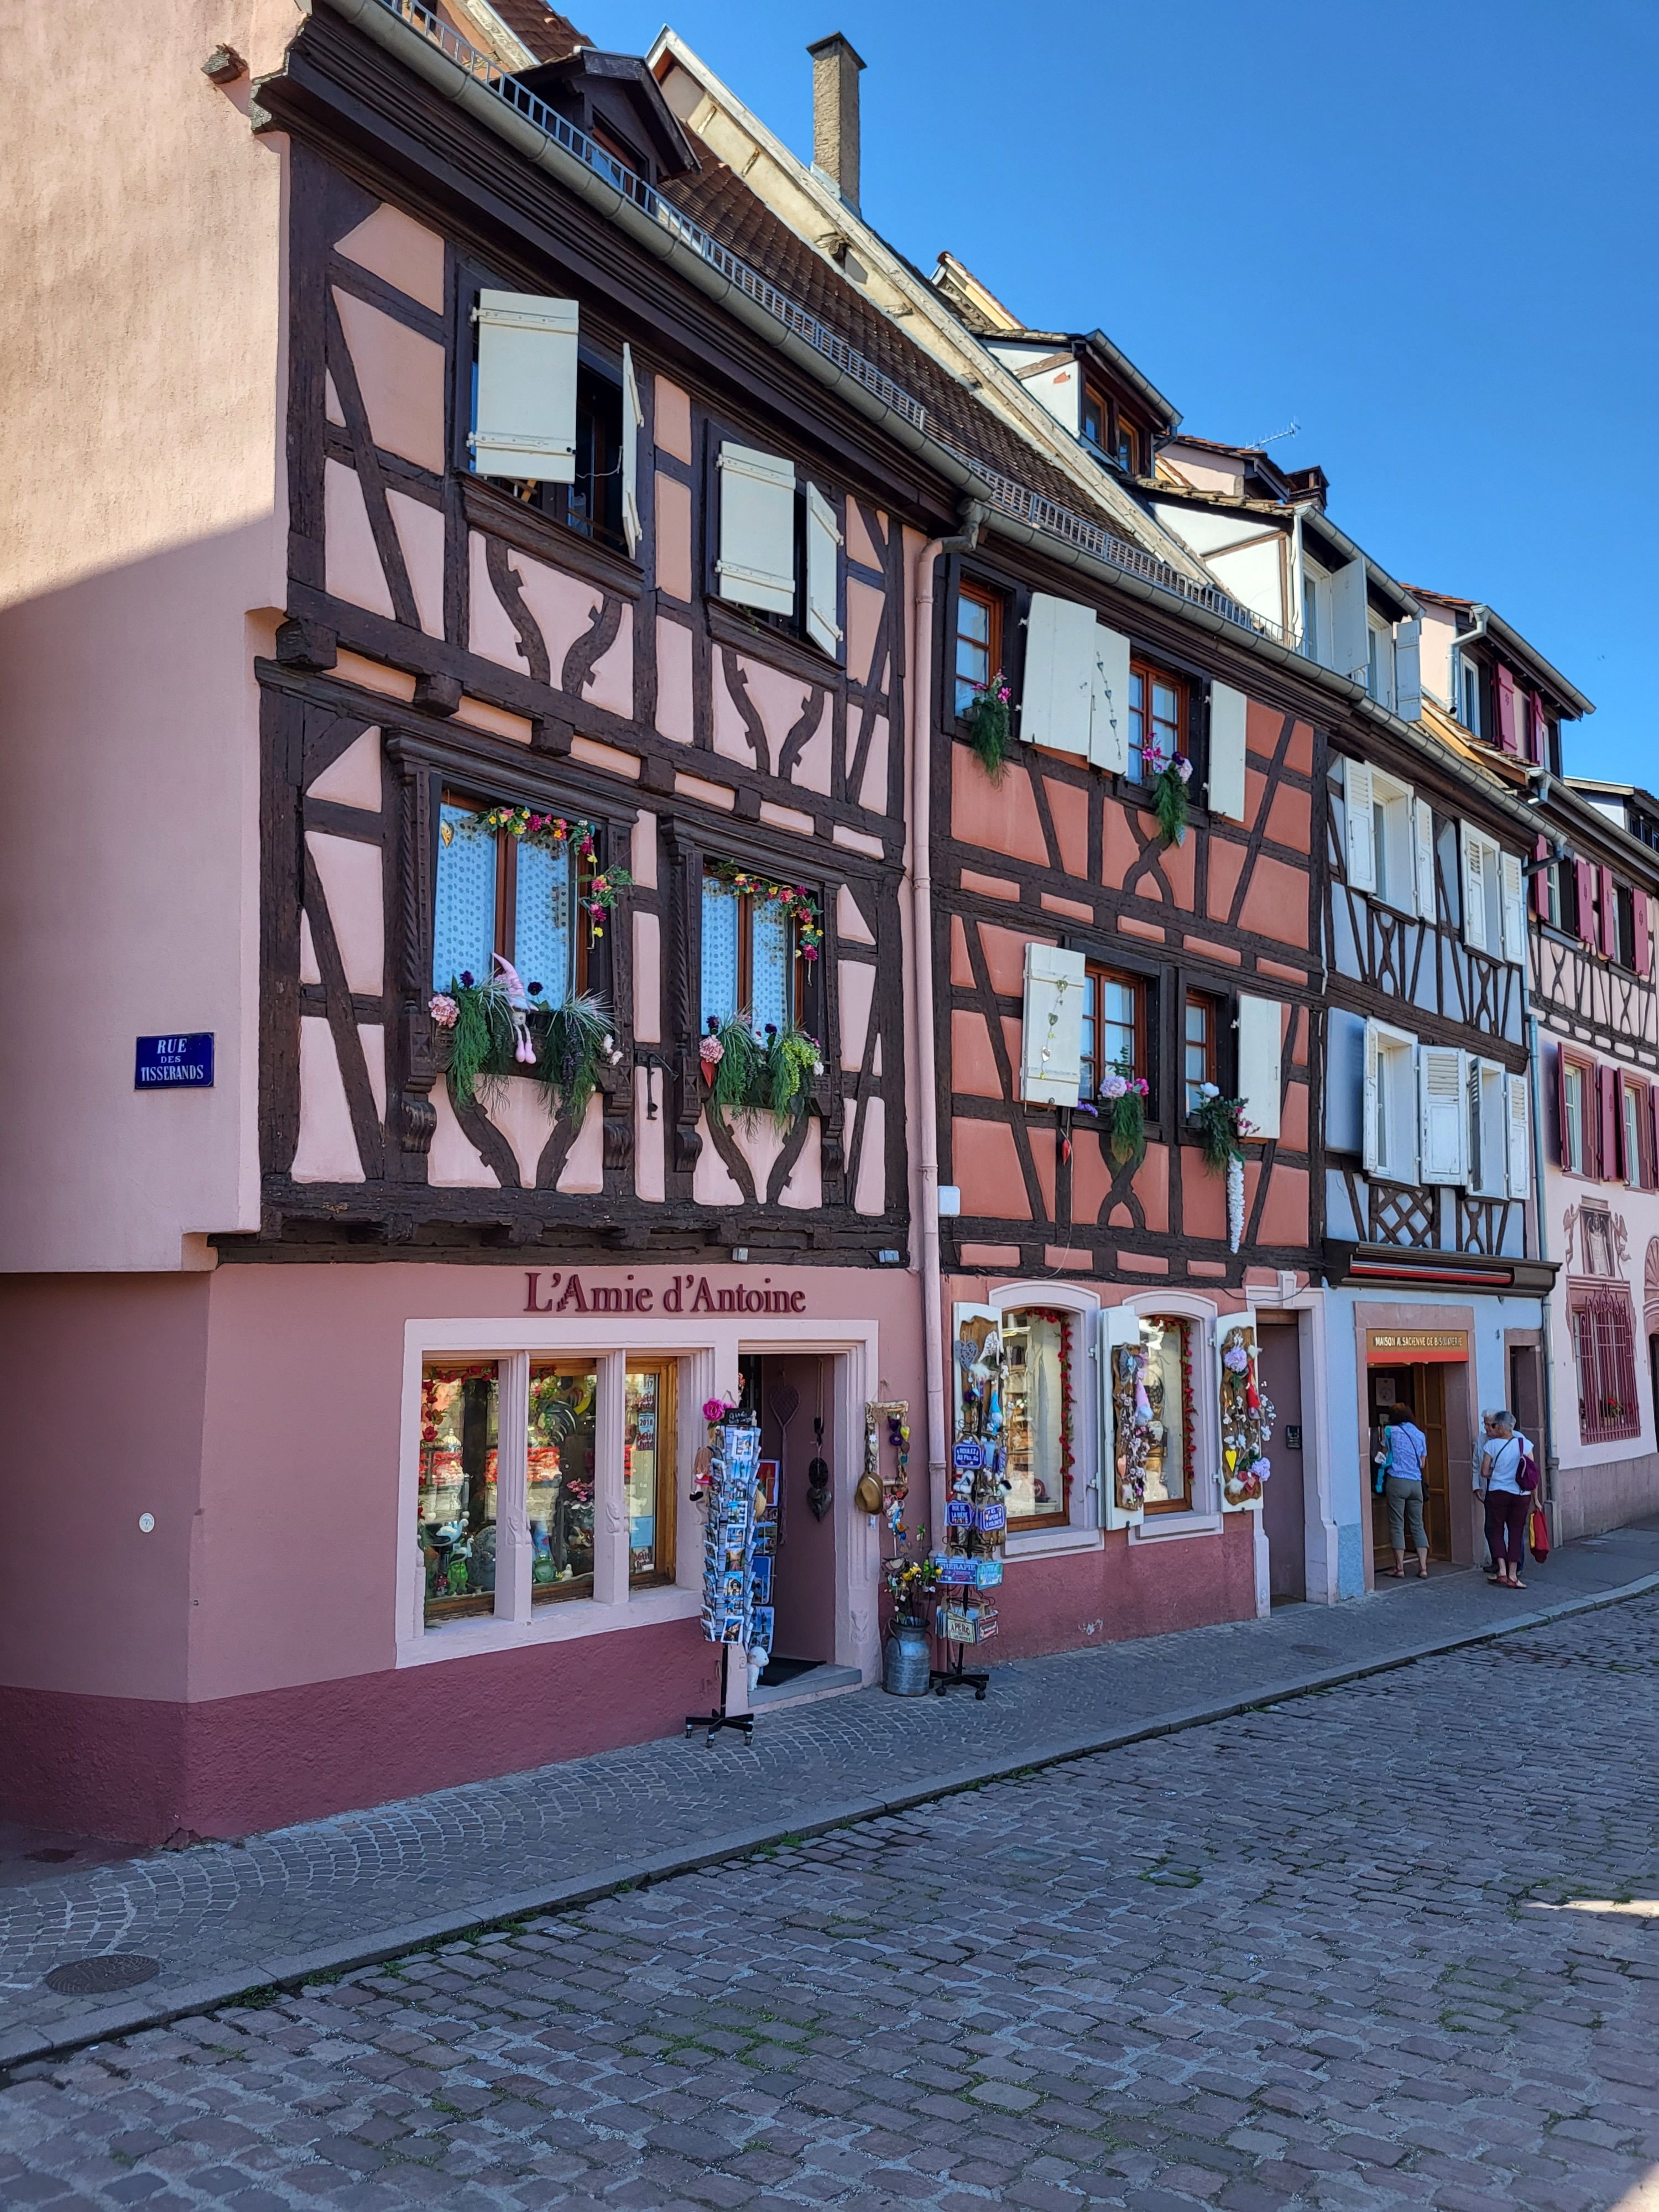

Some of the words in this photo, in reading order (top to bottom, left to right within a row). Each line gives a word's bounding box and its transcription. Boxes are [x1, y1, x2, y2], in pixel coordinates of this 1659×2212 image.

[156, 1038, 187, 1054] RUE
[140, 1065, 204, 1082] TISSERANDS
[1375, 1336, 1395, 1347] MAISON
[1396, 1336, 1426, 1347] ALSACIENNE
[1427, 1337, 1433, 1346] DE
